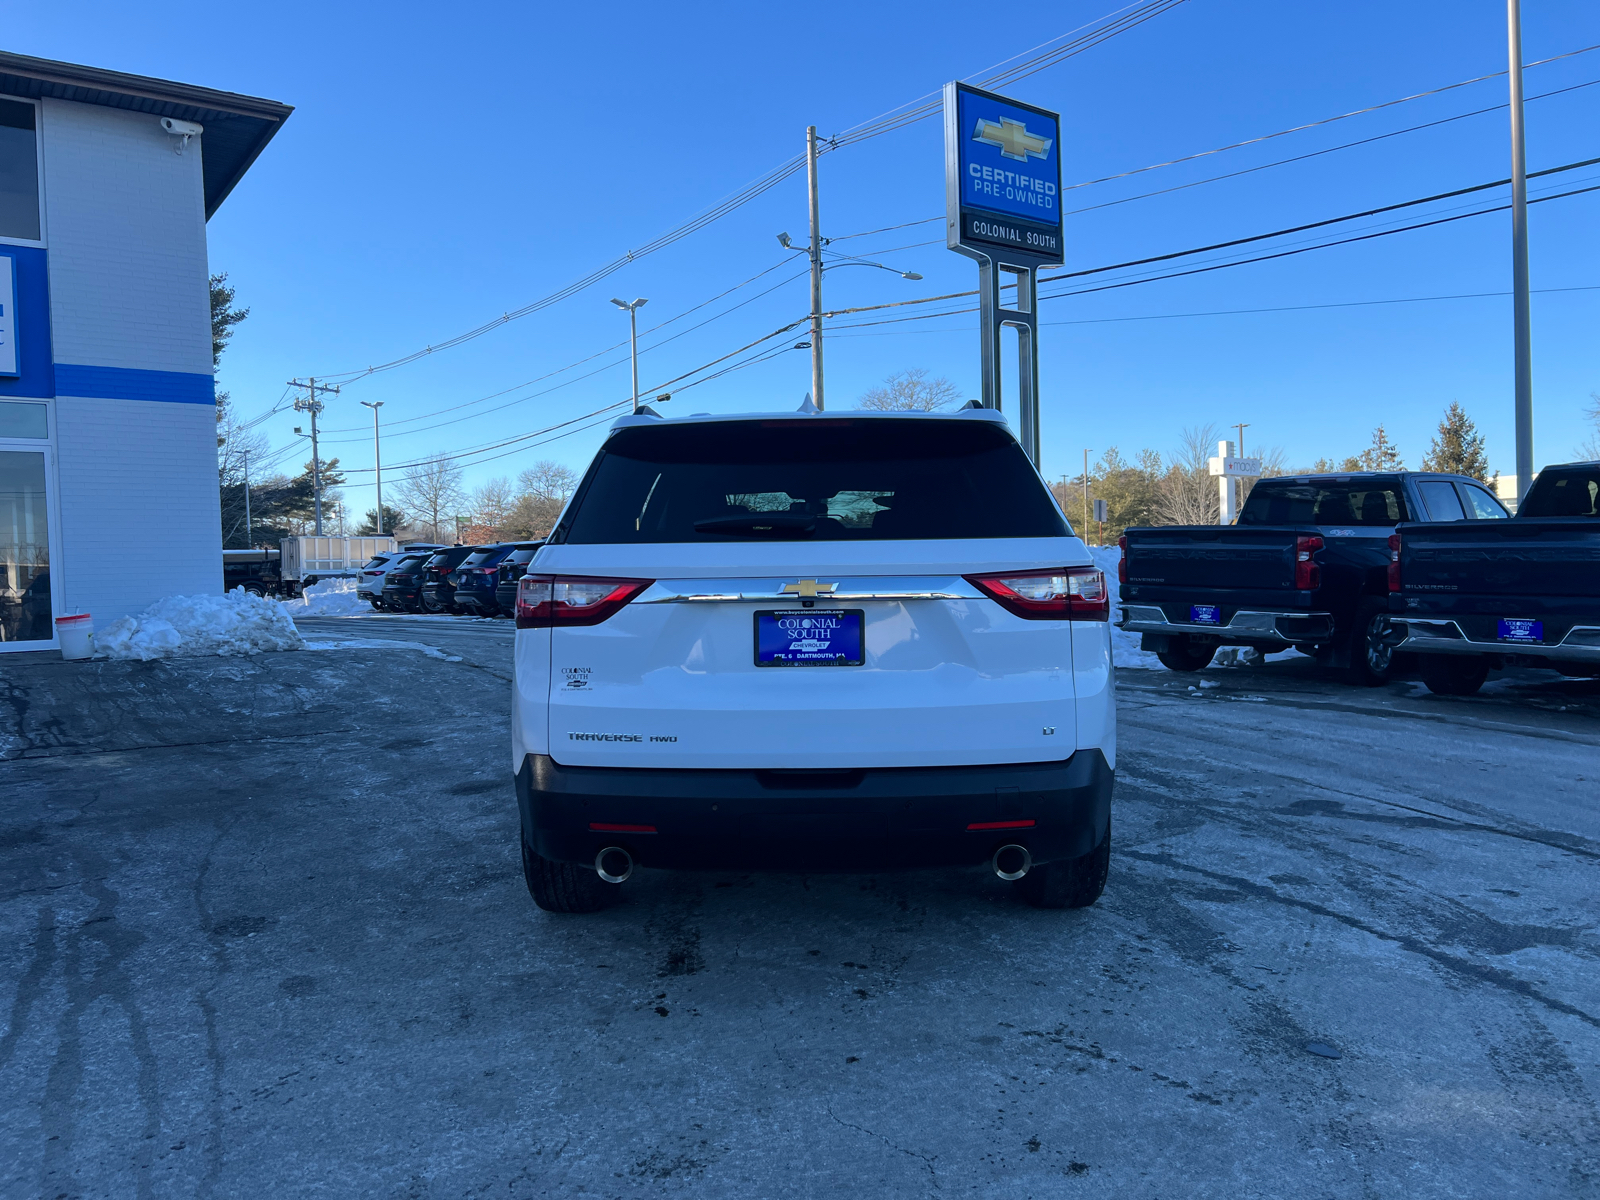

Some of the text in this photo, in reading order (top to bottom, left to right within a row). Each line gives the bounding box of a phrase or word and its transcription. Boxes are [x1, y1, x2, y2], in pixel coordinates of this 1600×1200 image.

[969, 163, 1056, 196] CERTIFIED
[974, 179, 1053, 209] PRE-OWNED
[973, 220, 1056, 249] COLONIAL SOUTH
[1233, 461, 1257, 474] macy's
[778, 618, 841, 629] COLONIAL
[787, 629, 831, 639] SOUTH
[1043, 726, 1057, 735] LT
[567, 731, 678, 743] TRAVERSE AWD
